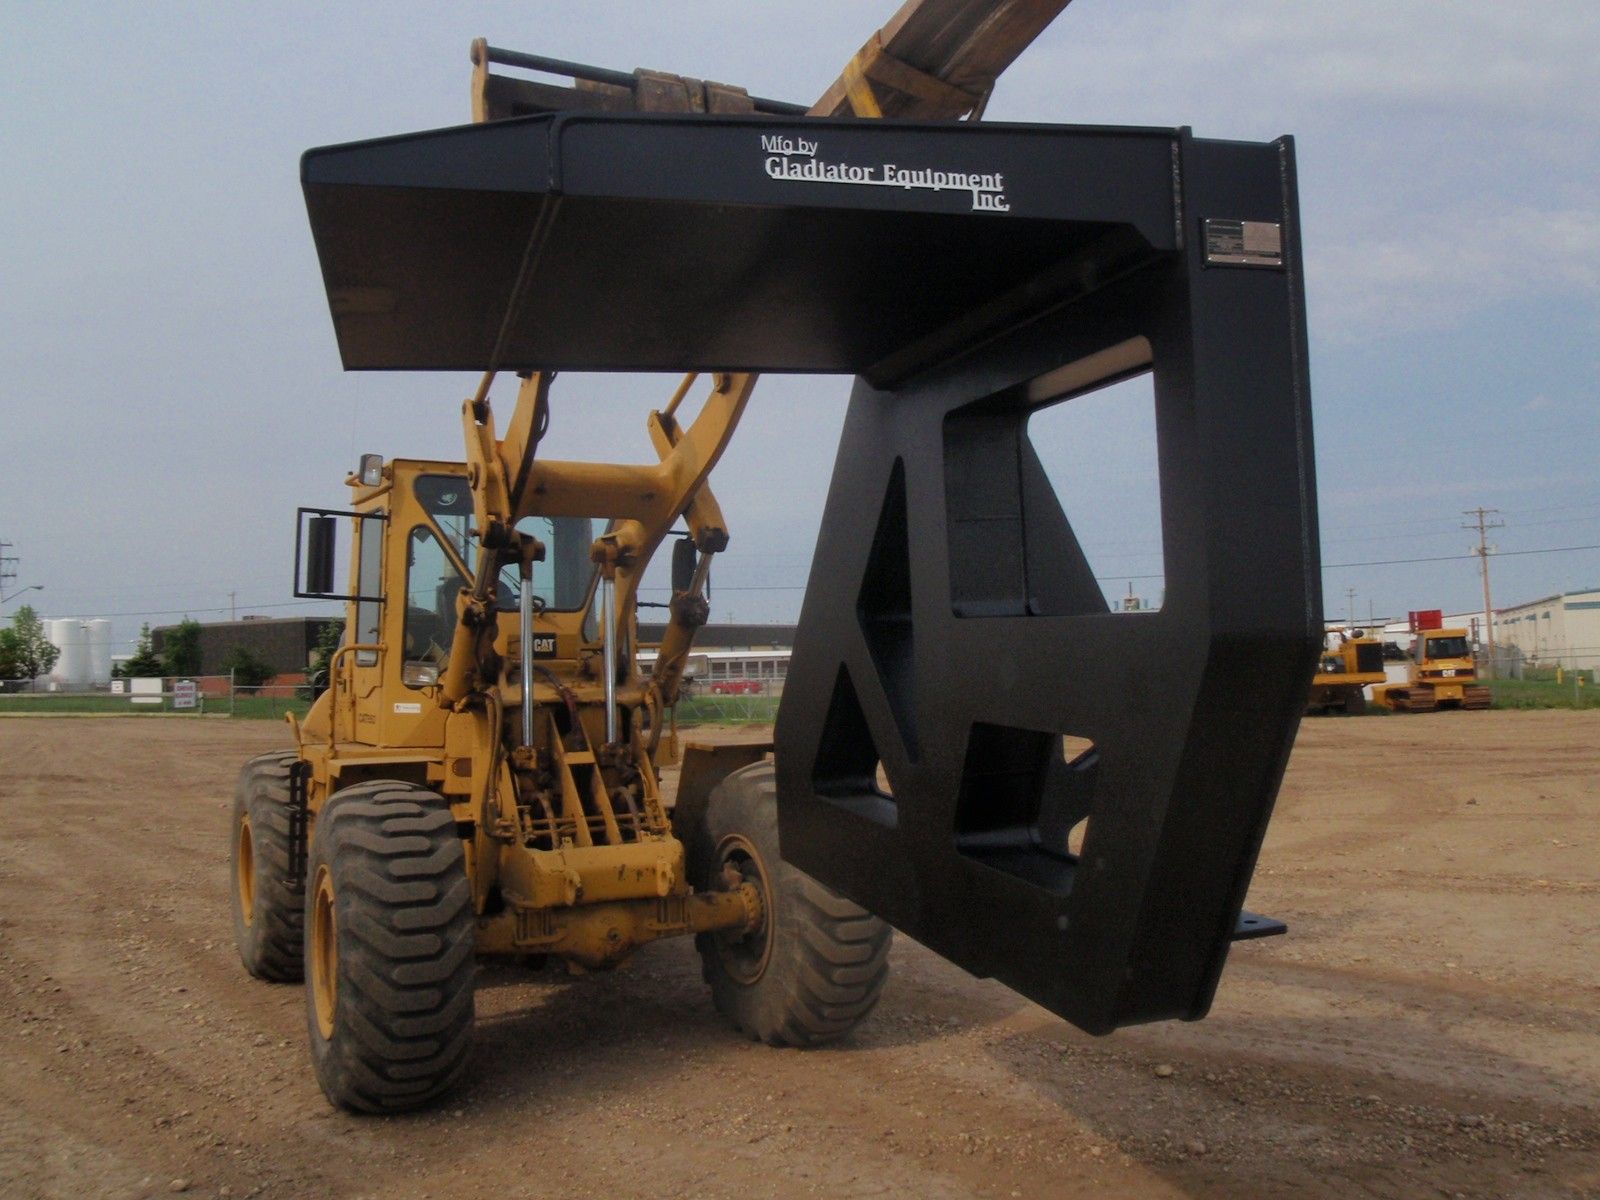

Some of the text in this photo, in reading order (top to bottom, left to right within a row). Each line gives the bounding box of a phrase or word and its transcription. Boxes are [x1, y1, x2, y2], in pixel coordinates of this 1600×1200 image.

[761, 135, 818, 157] Mfg by
[765, 157, 1003, 191] Gladiator Equipment
[972, 187, 1010, 211] Inc.
[533, 638, 555, 652] CAT
